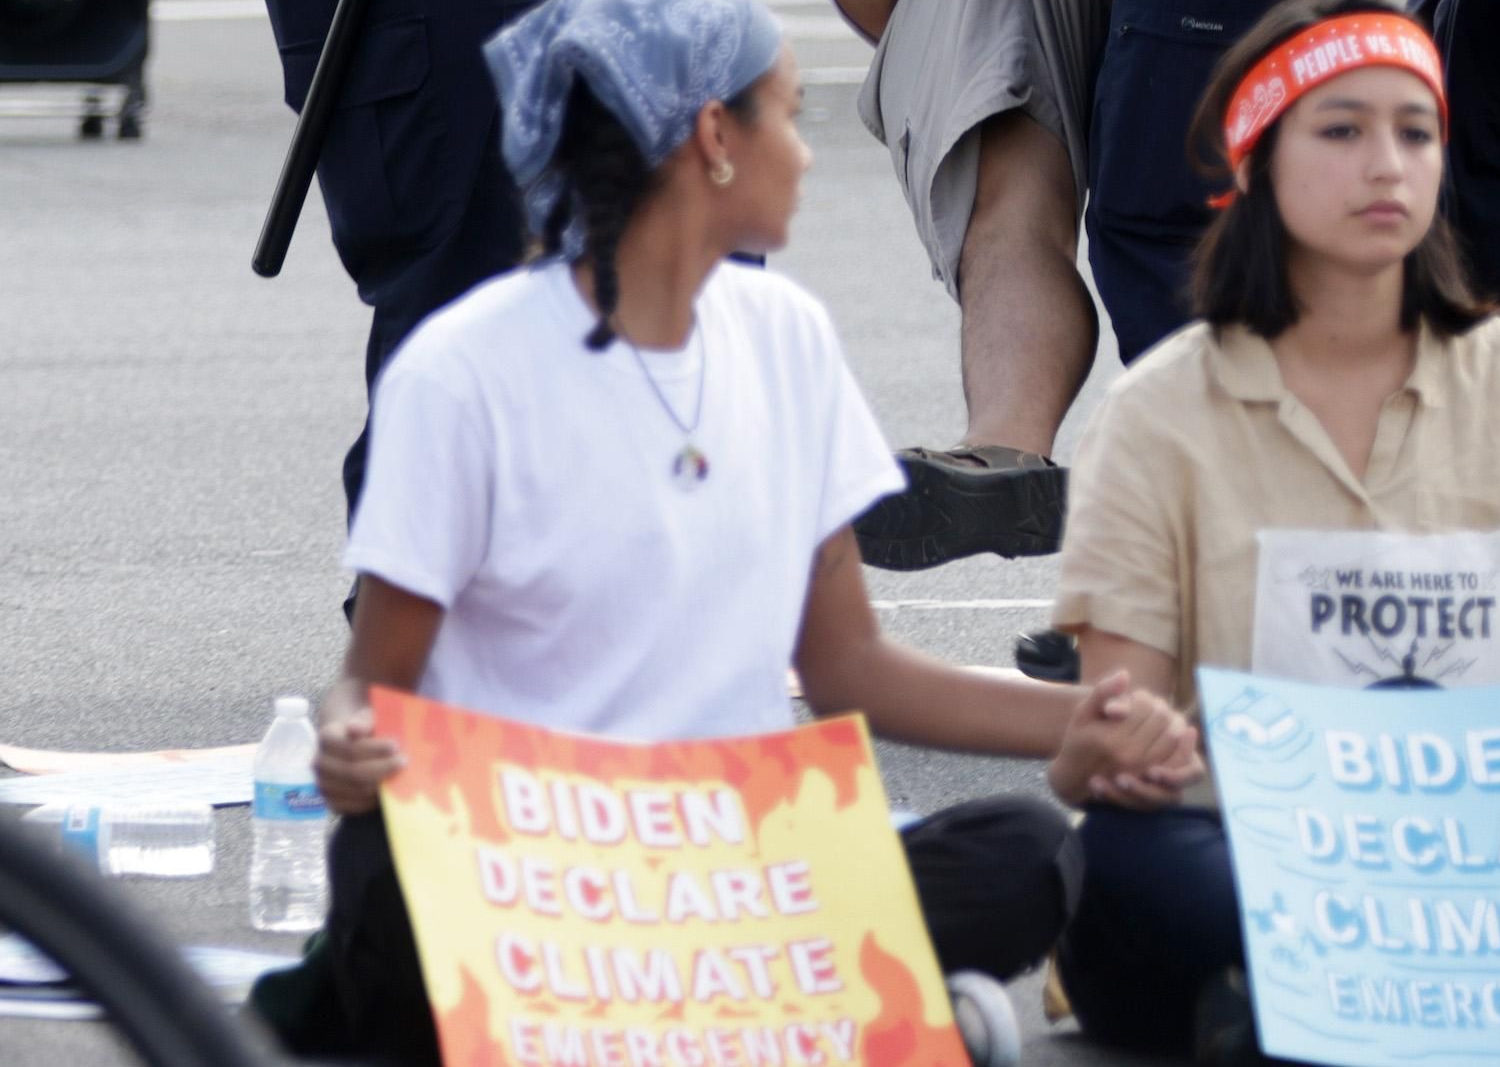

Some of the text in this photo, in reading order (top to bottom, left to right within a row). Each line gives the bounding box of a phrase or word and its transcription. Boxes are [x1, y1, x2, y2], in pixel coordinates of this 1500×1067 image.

[1293, 35, 1364, 84] PEOPLE
[1366, 35, 1397, 55] VS.
[1336, 570, 1479, 591] WE ARE HERE TO
[1310, 592, 1497, 639] PROTECT
[499, 769, 745, 846] BIDEN
[477, 847, 820, 923] DECLARE
[495, 936, 845, 1004] CLIMATE
[509, 1017, 859, 1067] EMERGENCY
